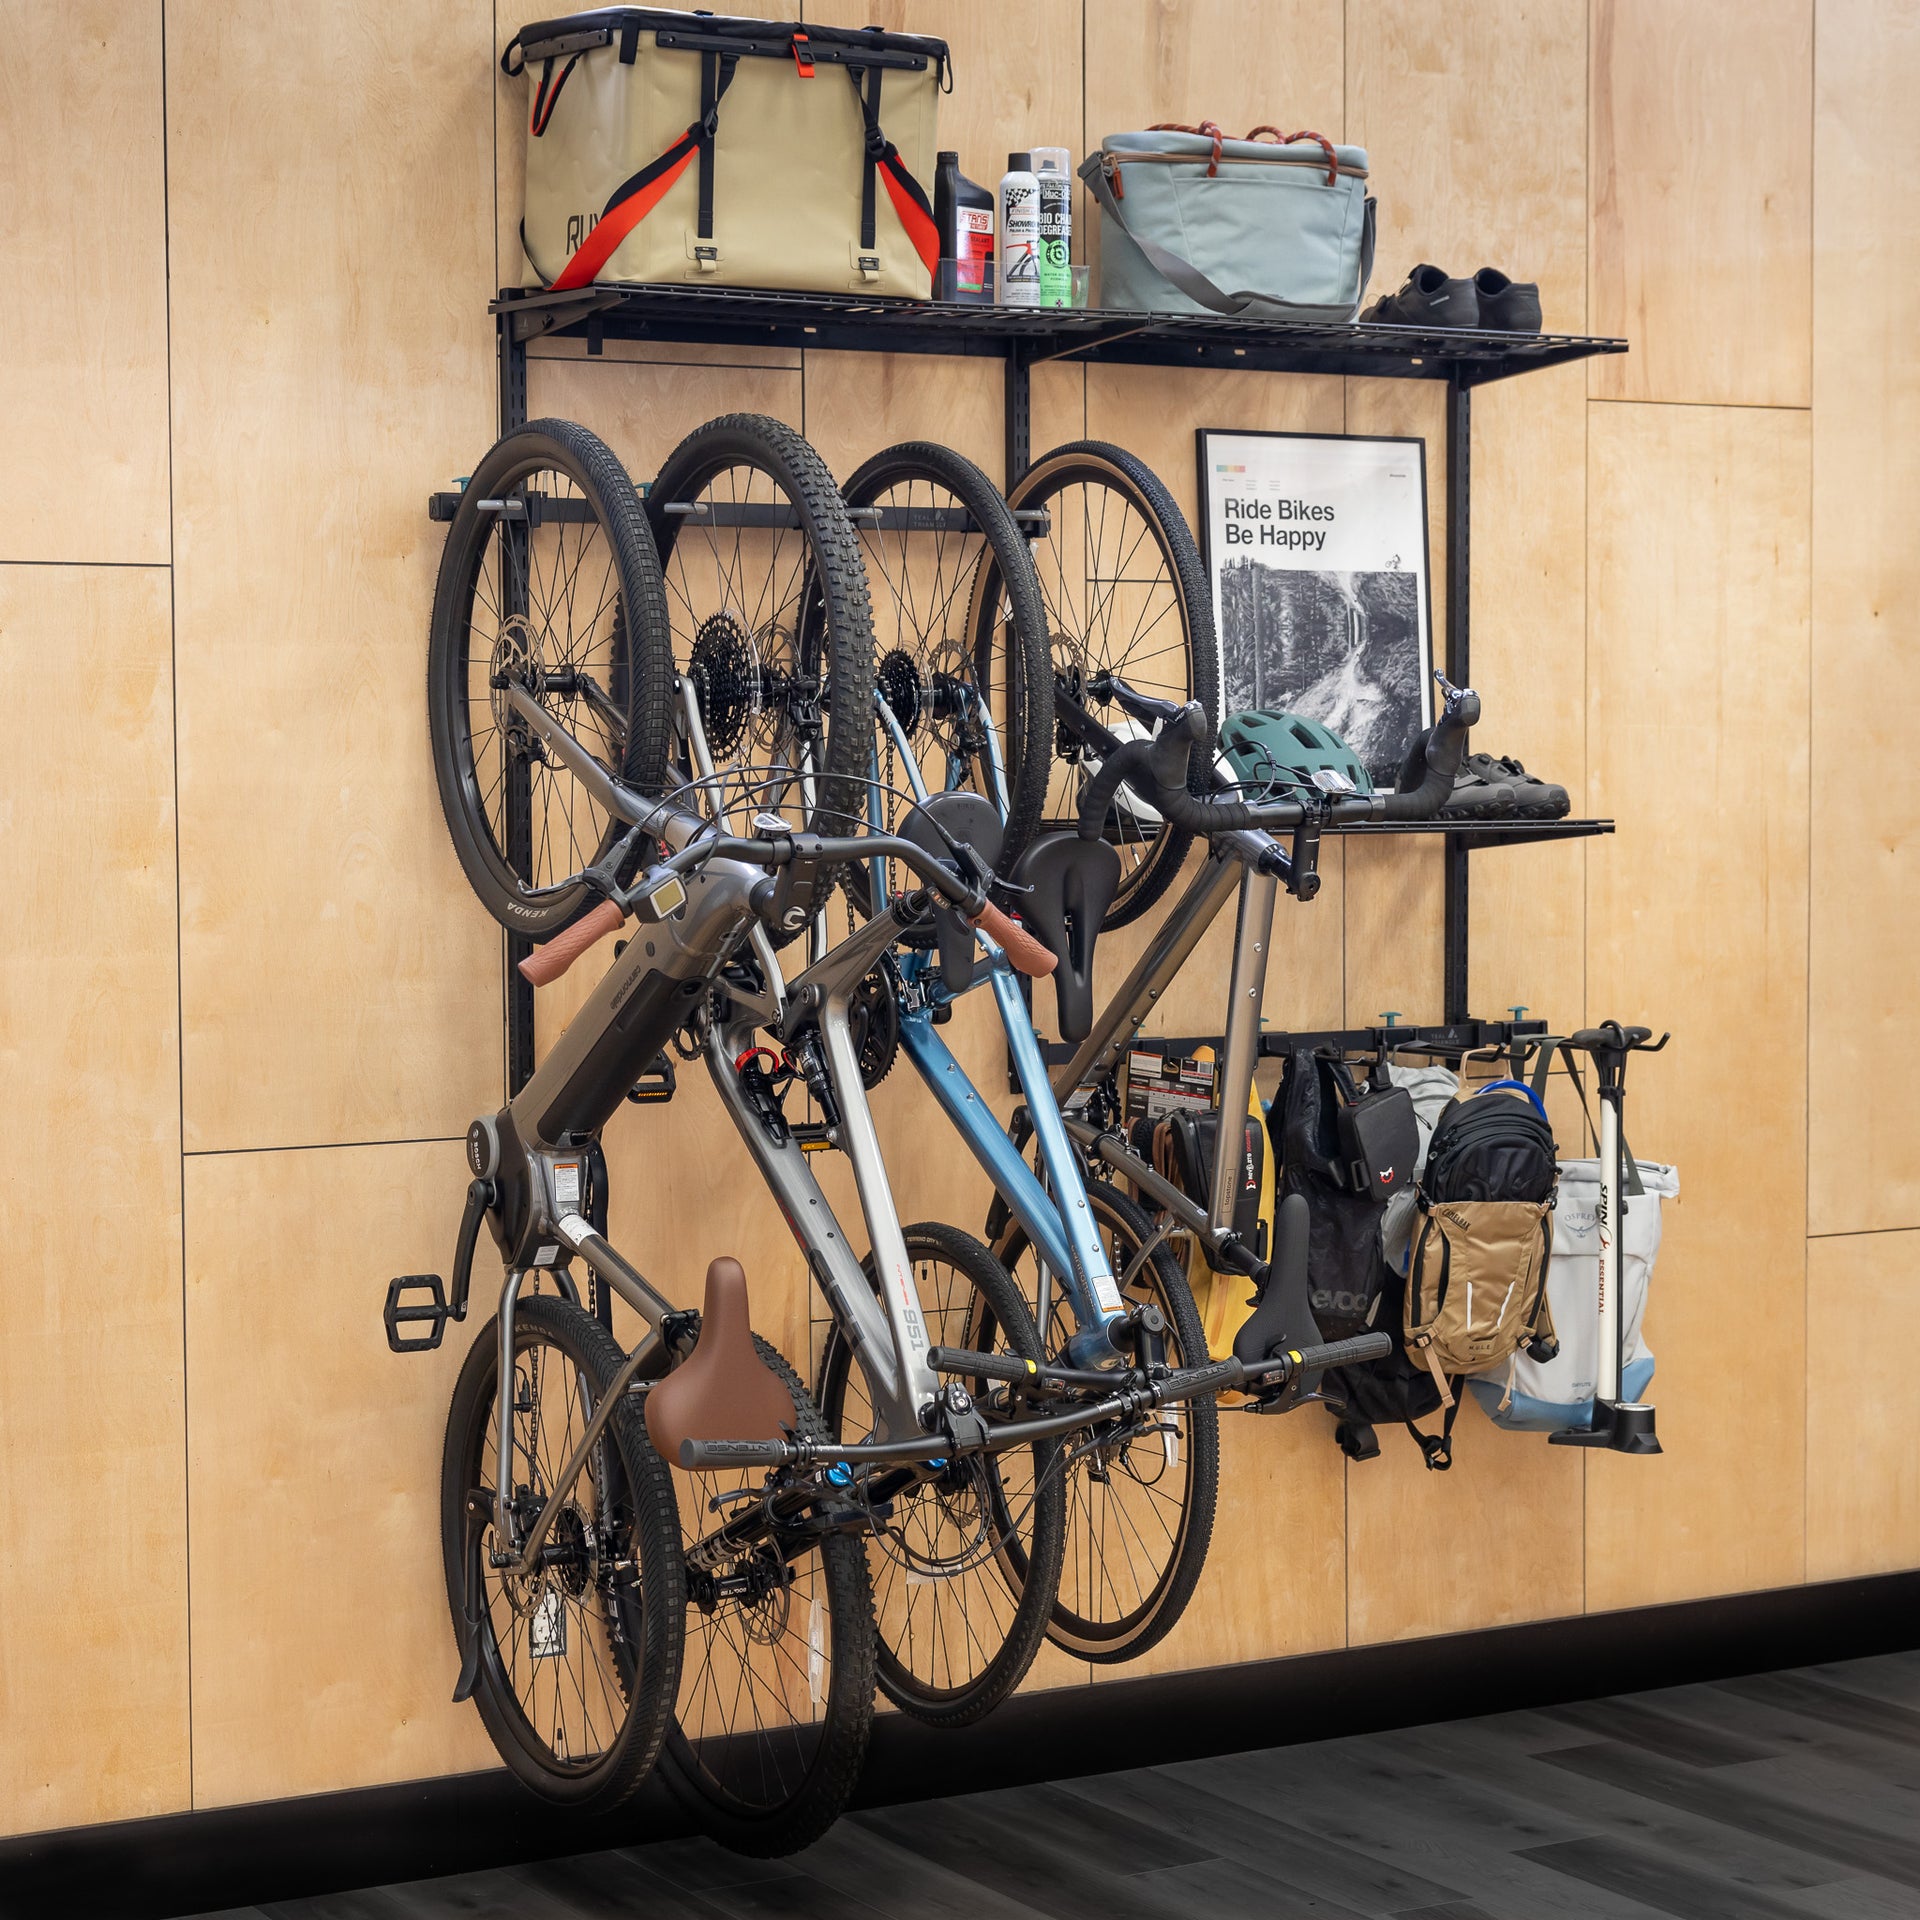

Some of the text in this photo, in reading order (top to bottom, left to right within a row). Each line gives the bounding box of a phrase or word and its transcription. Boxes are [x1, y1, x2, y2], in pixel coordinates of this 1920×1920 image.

[566, 213, 600, 255] RU
[1224, 498, 1335, 521] Ride Bikes
[1226, 523, 1326, 551] Be Happy
[507, 901, 549, 918] KENDA
[473, 1141, 481, 1170] BOSCH
[1224, 1176, 1233, 1206] topstone
[1600, 1182, 1608, 1226] SPIN
[1564, 1212, 1595, 1222] OSPREY
[1312, 1289, 1368, 1311] evoc
[902, 1308, 925, 1351] 951
